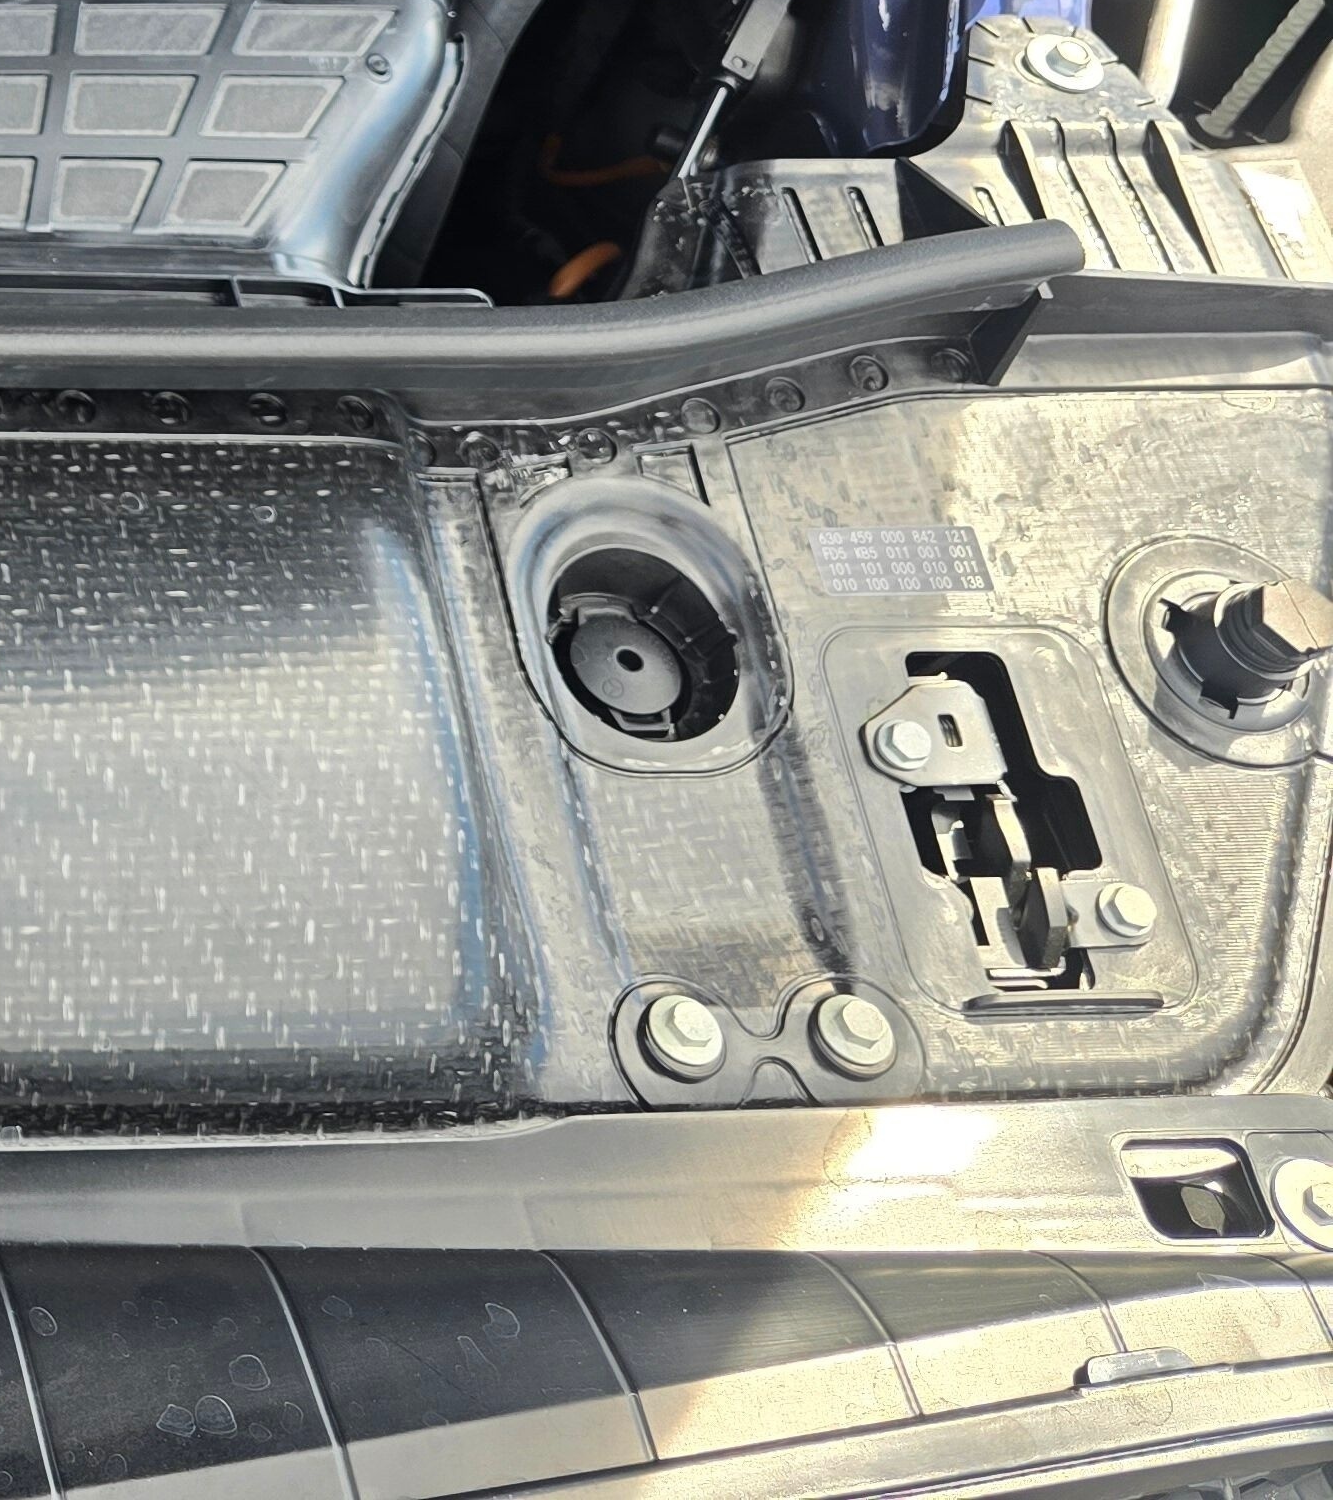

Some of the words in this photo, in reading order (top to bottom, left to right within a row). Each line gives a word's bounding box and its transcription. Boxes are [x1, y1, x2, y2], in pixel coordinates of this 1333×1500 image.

[818, 532, 843, 546] 630
[849, 531, 874, 544] 459
[880, 530, 906, 544] 000
[911, 530, 937, 543] 842
[945, 529, 969, 543] 121
[885, 546, 910, 559] 011
[916, 545, 942, 559] 001
[948, 545, 973, 558] 001
[829, 562, 852, 576] 101
[860, 562, 884, 575] 101
[890, 561, 916, 575] 000
[922, 560, 948, 574] 010
[954, 560, 979, 574] 011
[832, 577, 858, 591] 010
[865, 577, 890, 591] 100
[897, 577, 921, 590] 100
[929, 576, 953, 590] 100
[960, 575, 985, 589] 138
